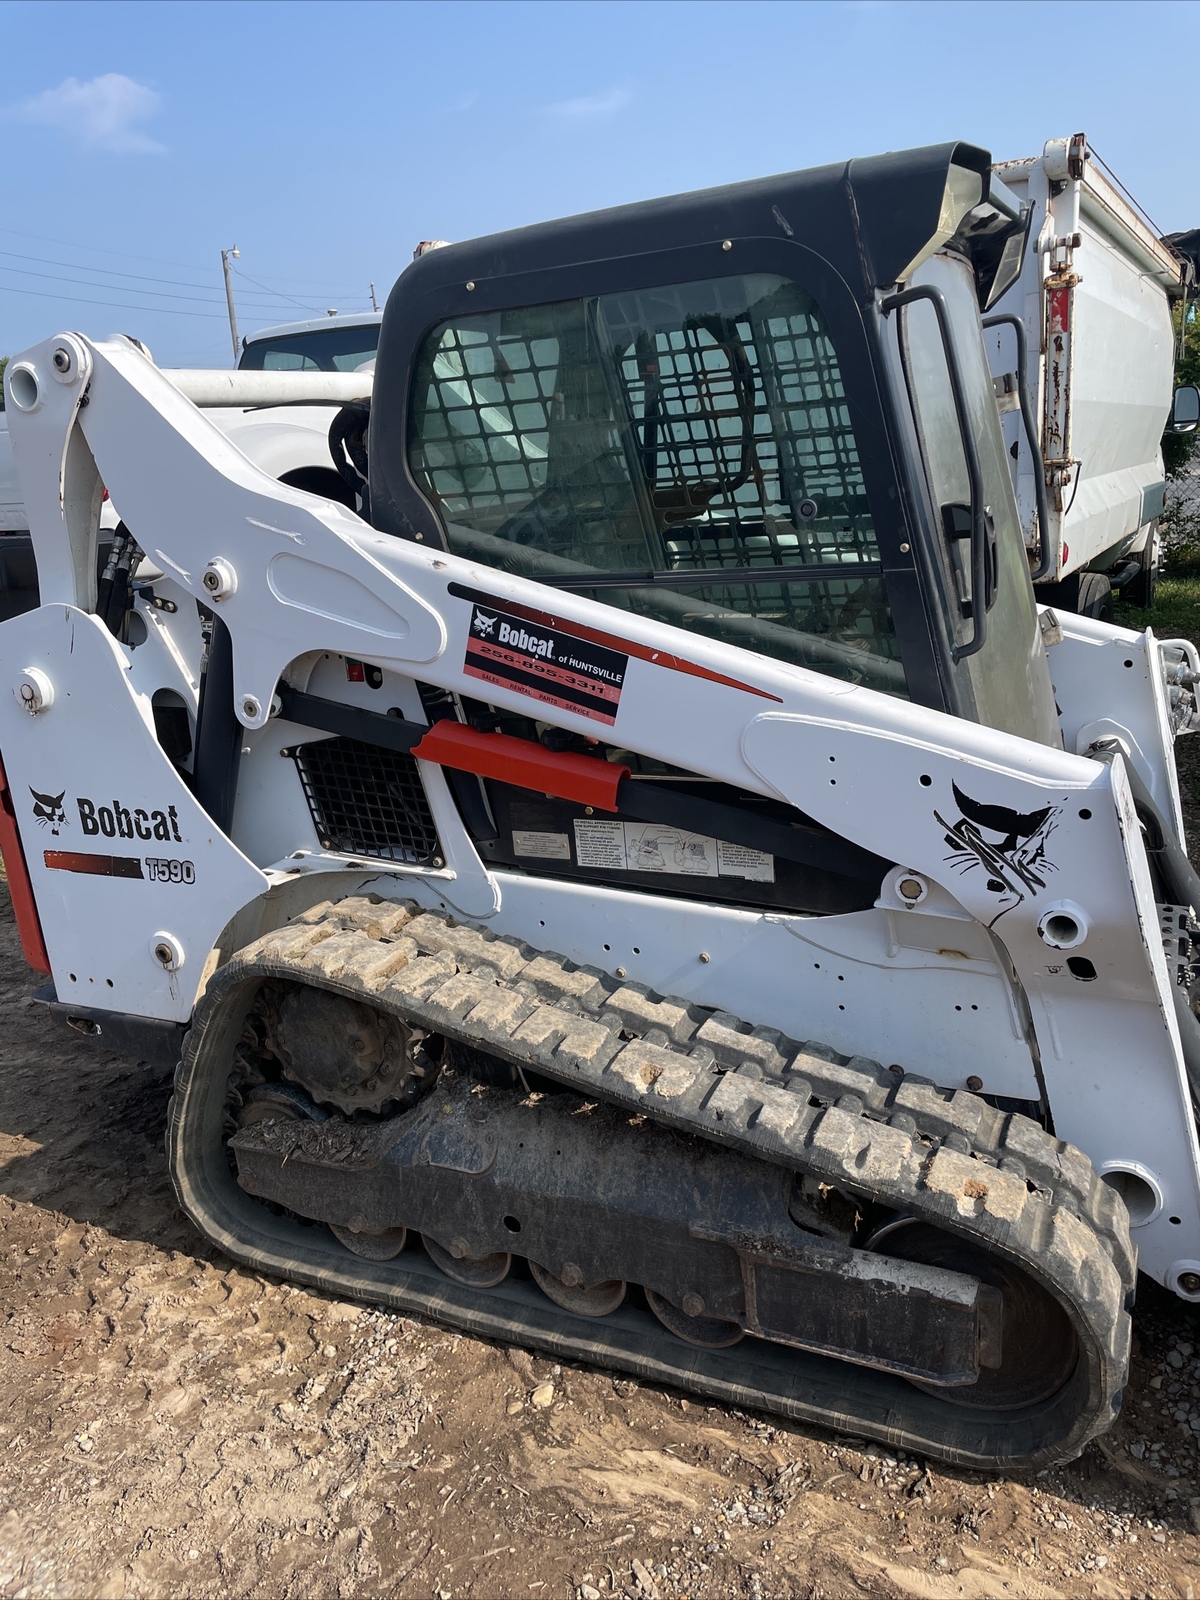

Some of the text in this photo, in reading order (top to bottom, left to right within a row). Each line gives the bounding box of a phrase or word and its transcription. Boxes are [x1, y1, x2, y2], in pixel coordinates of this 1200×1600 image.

[480, 646, 605, 694] 256-895-3311
[498, 622, 623, 683] Bobcat of HUNTSVILLE
[481, 673, 590, 717] SALES RENTAL PARTS SERVICE
[76, 797, 183, 842] Bobcat
[145, 857, 196, 885] T590
